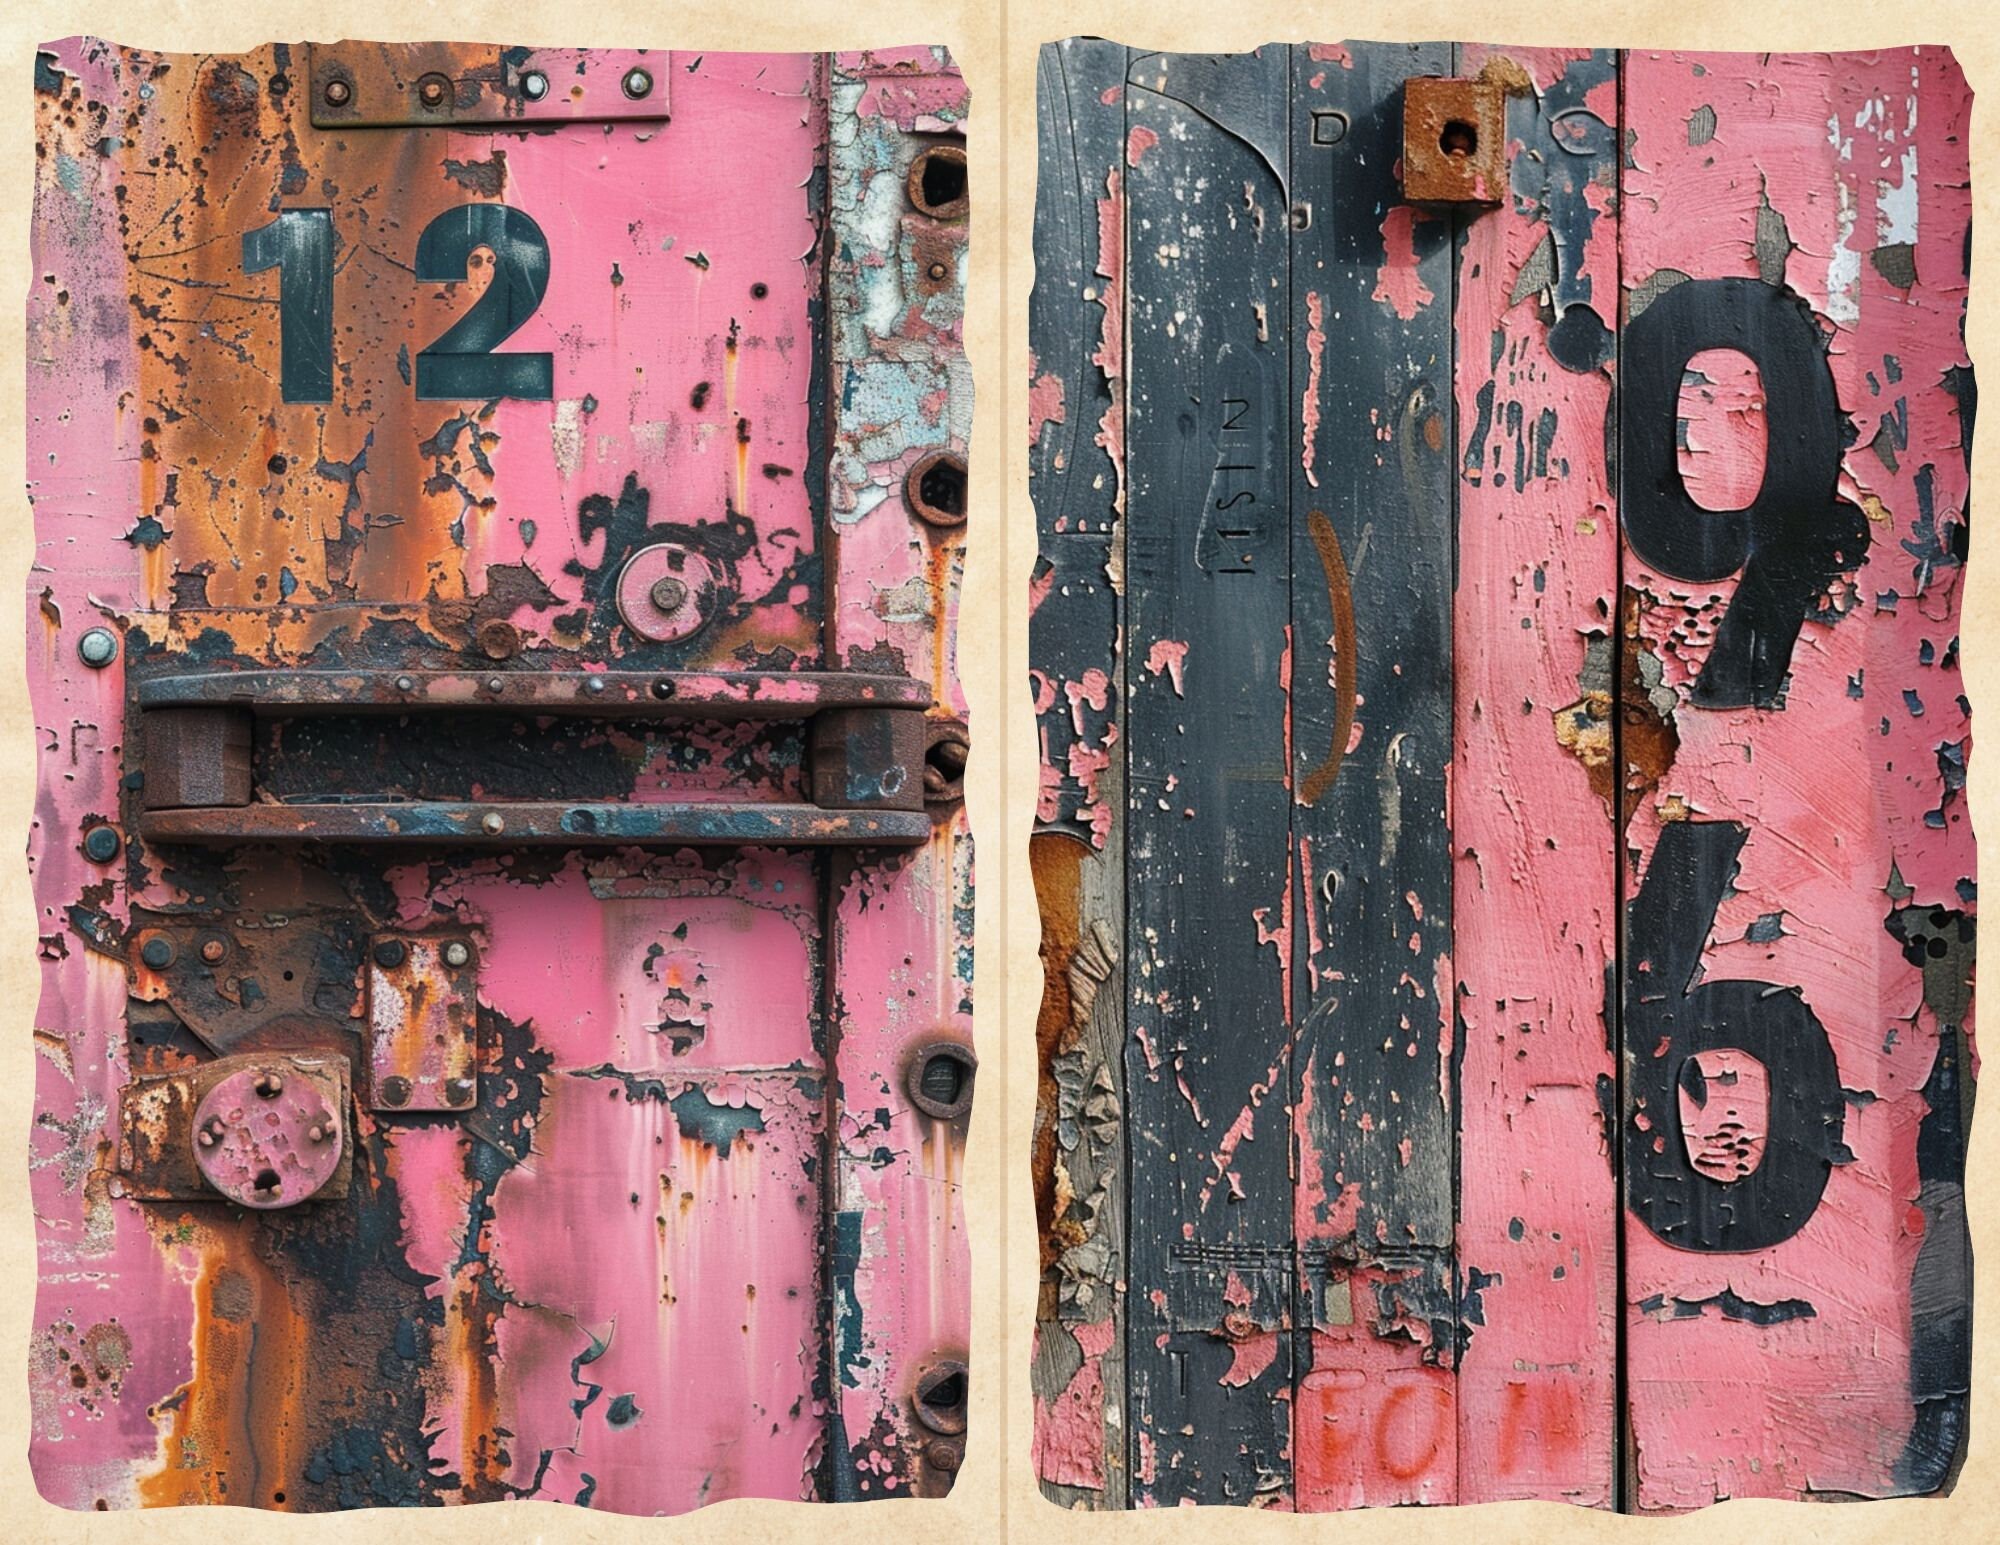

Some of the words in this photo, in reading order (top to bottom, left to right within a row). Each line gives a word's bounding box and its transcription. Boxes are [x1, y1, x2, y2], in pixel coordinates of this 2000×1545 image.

[242, 203, 554, 405] 12
[1621, 278, 1848, 710] 9
[1622, 819, 1845, 1253] 6
